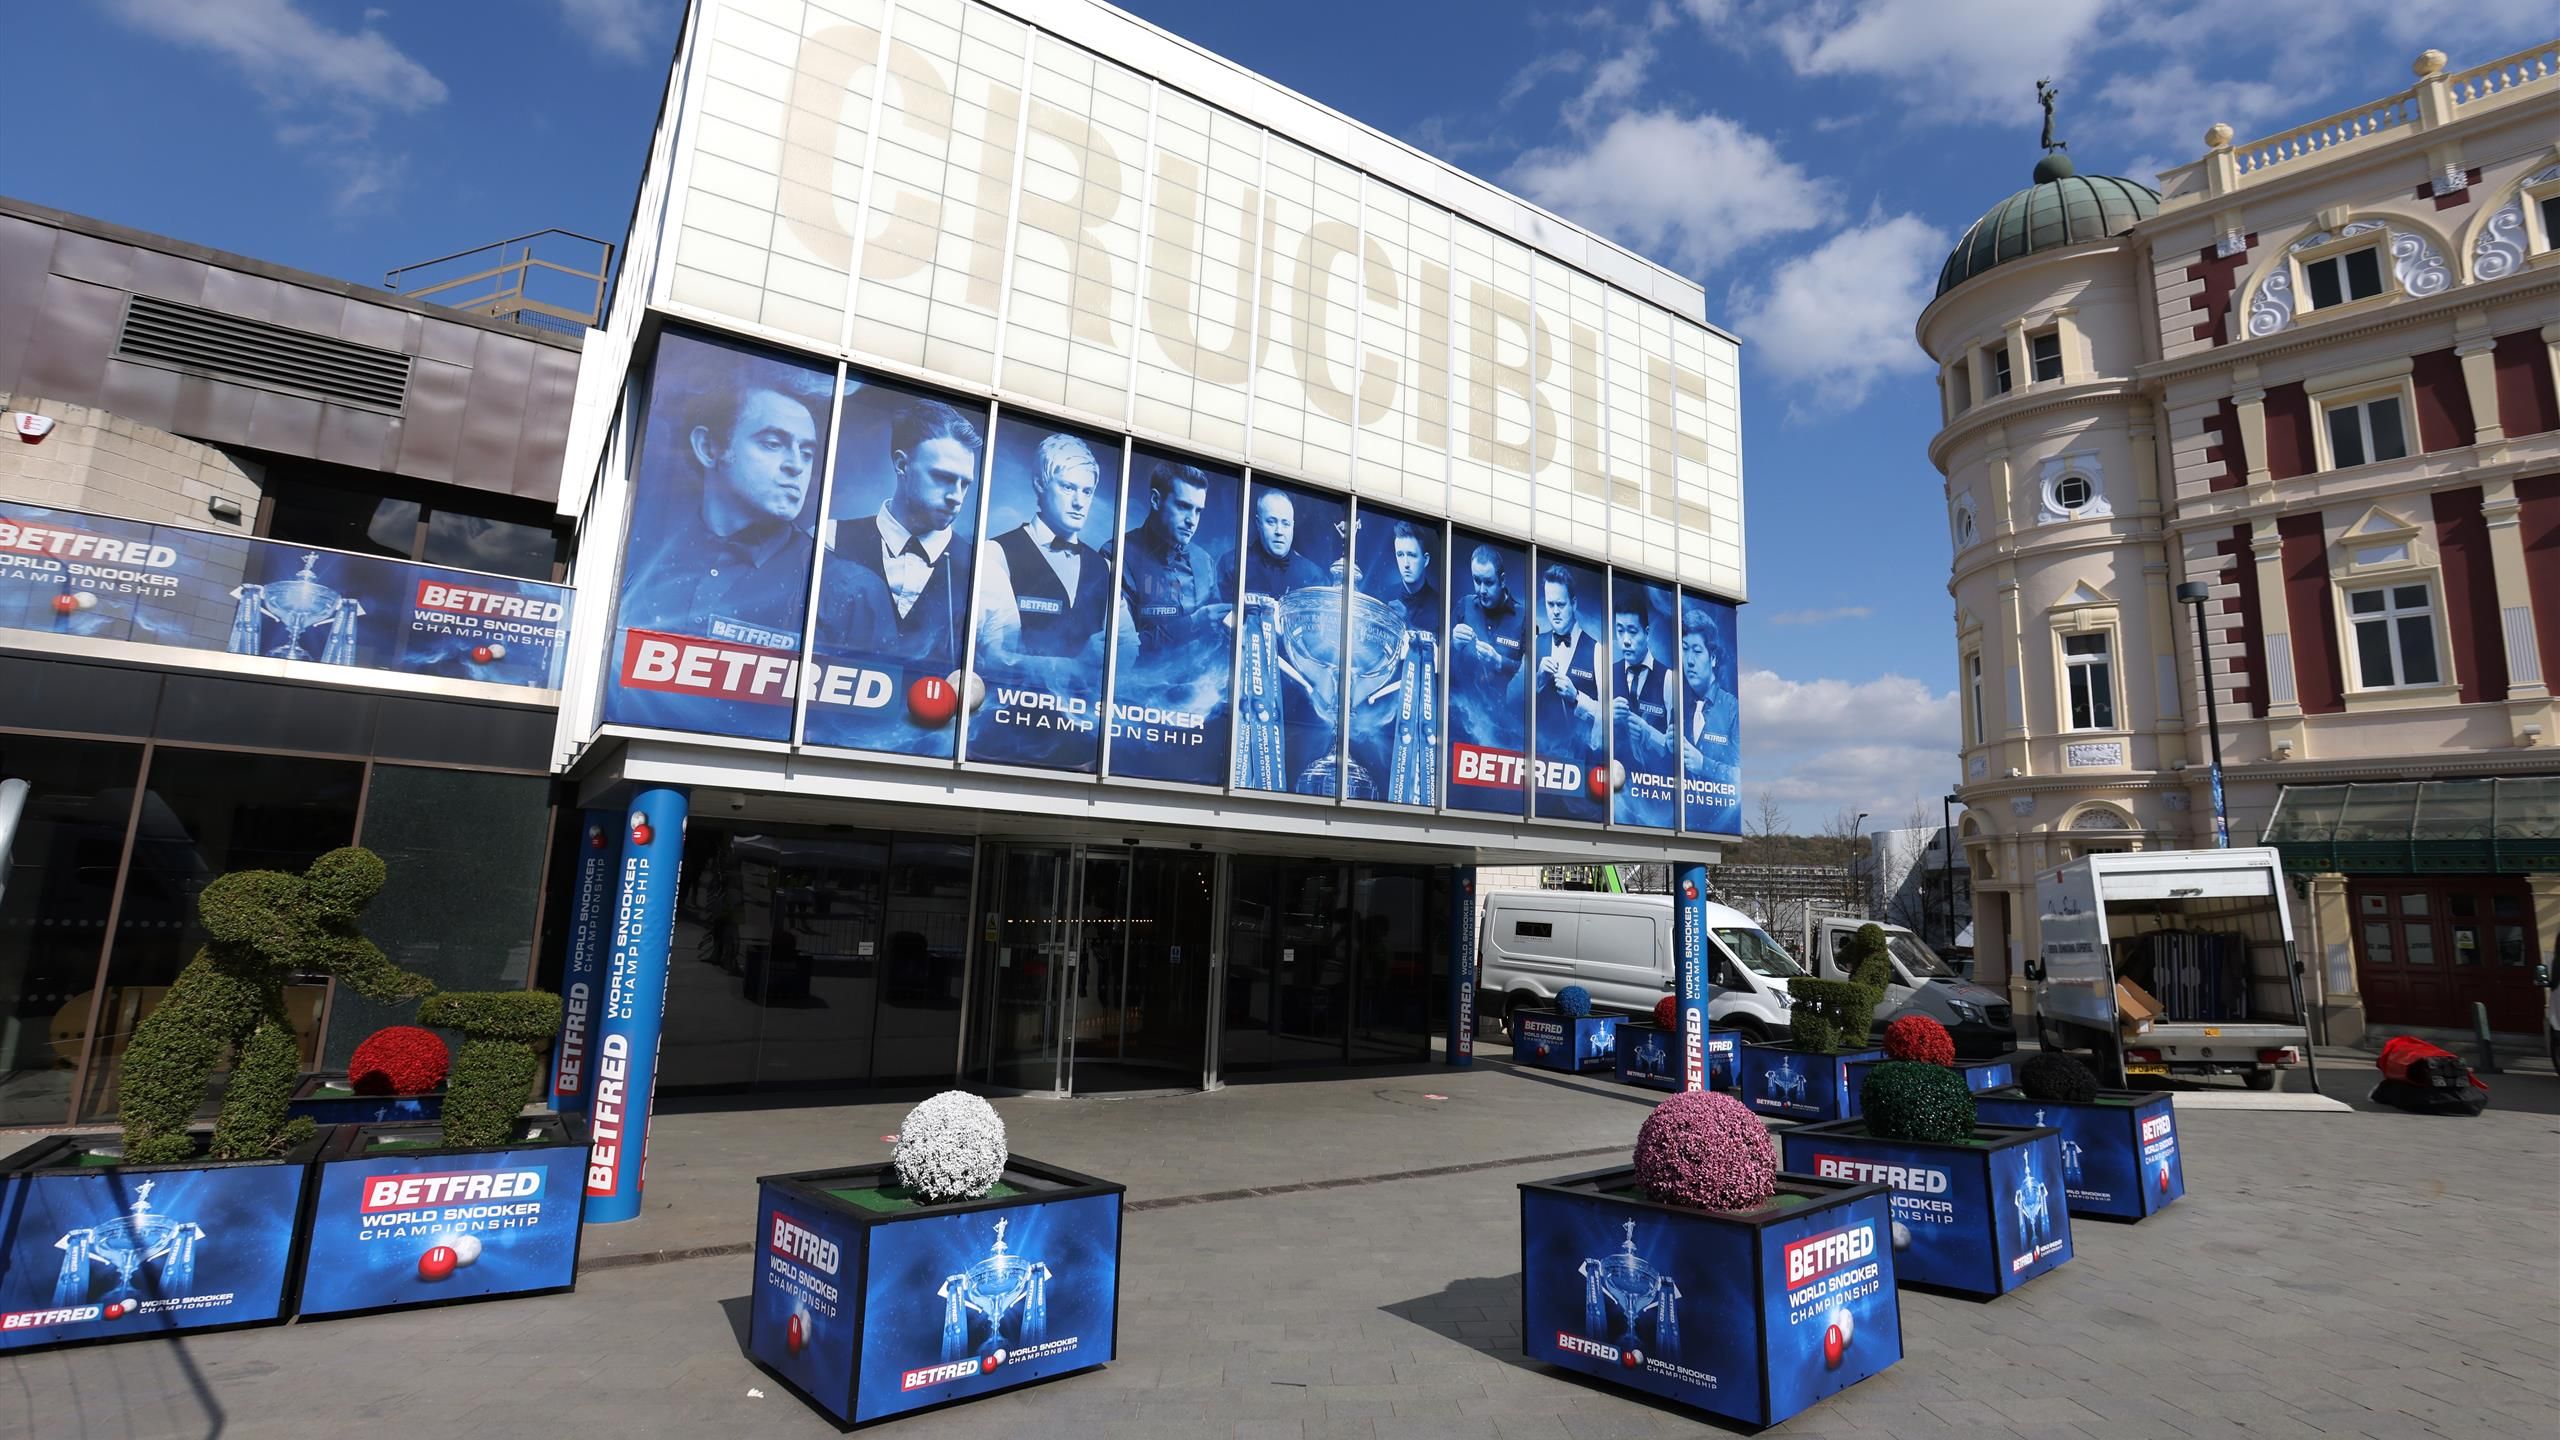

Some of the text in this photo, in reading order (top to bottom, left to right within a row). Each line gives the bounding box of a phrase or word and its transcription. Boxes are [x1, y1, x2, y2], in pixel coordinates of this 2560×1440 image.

[779, 24, 1711, 533] CRUCIBLE
[0, 522, 177, 568] BETFRED
[0, 554, 179, 588] ORLD SNOOKER
[0, 567, 176, 598] HAMPIONSHIP
[422, 585, 564, 622] BETFRED
[1020, 600, 1060, 612] BETFRED
[412, 622, 565, 647] CHAMPIONSHIP
[414, 610, 566, 639] WORLD SNOOKER
[712, 621, 795, 649] BETFRED
[1496, 637, 1519, 647] BETFRED
[632, 640, 893, 708] BETFRED
[1251, 633, 1263, 696] BETFRED
[997, 687, 1086, 715] WORLD
[1402, 661, 1416, 720] BETFRED
[1422, 663, 1432, 720] BETFRED
[994, 710, 1203, 746] CHAMPONSHIP
[1458, 750, 1582, 791] BETFRED
[1630, 771, 1674, 788] WORLD
[1631, 788, 1736, 808] CHAMONSHIP
[573, 857, 596, 972] WORLD SNOOKER
[584, 858, 605, 972] CHAMPIONSHIP
[607, 857, 637, 1019] WORLD SNOOKER
[621, 858, 650, 1019] CHAMPIONSHIP
[1461, 899, 1470, 976] WORLD SNOOKER
[1693, 906, 1701, 1000] CHAMPIONSHIP
[1685, 961, 1693, 1000] WORLD
[1459, 982, 1472, 1053] BETFRED
[1525, 1020, 1562, 1034] BETFRED
[559, 982, 589, 1092] BETFRED
[1686, 1008, 1702, 1092] BETFRED
[1709, 1041, 1733, 1052] TFRED
[588, 1034, 628, 1191] BETFRED
[368, 1172, 540, 1207] BETFRED
[1820, 1159, 1947, 1194] BETFRED
[359, 1216, 539, 1240] CHAMPIONSHIP
[362, 1203, 541, 1227] WORLD SNOOKER
[773, 1218, 840, 1275] BETFRED
[1789, 1226, 1874, 1283] BETFRED
[768, 1272, 837, 1318] CHAMPIONSHIP
[770, 1255, 838, 1303] WORLD SNOOKER
[1789, 1263, 1878, 1308] WORLD SNOOKER
[3, 1307, 99, 1329] BETFRED
[139, 1300, 233, 1313] CHAMPIONSHIP
[141, 1293, 234, 1308] WORLD SNOOKER
[1791, 1280, 1880, 1325] CHAMPIONSHIP
[1008, 1344, 1078, 1365] CHAMPIONSHIP
[1009, 1337, 1078, 1357] WORLD SNOOKER
[1559, 1334, 1619, 1361] BETFRED
[905, 1360, 979, 1388] BETFRED
[1647, 1357, 1717, 1383] WORLD SNOOKER
[1647, 1365, 1717, 1389] CHAMPIONSHIP
